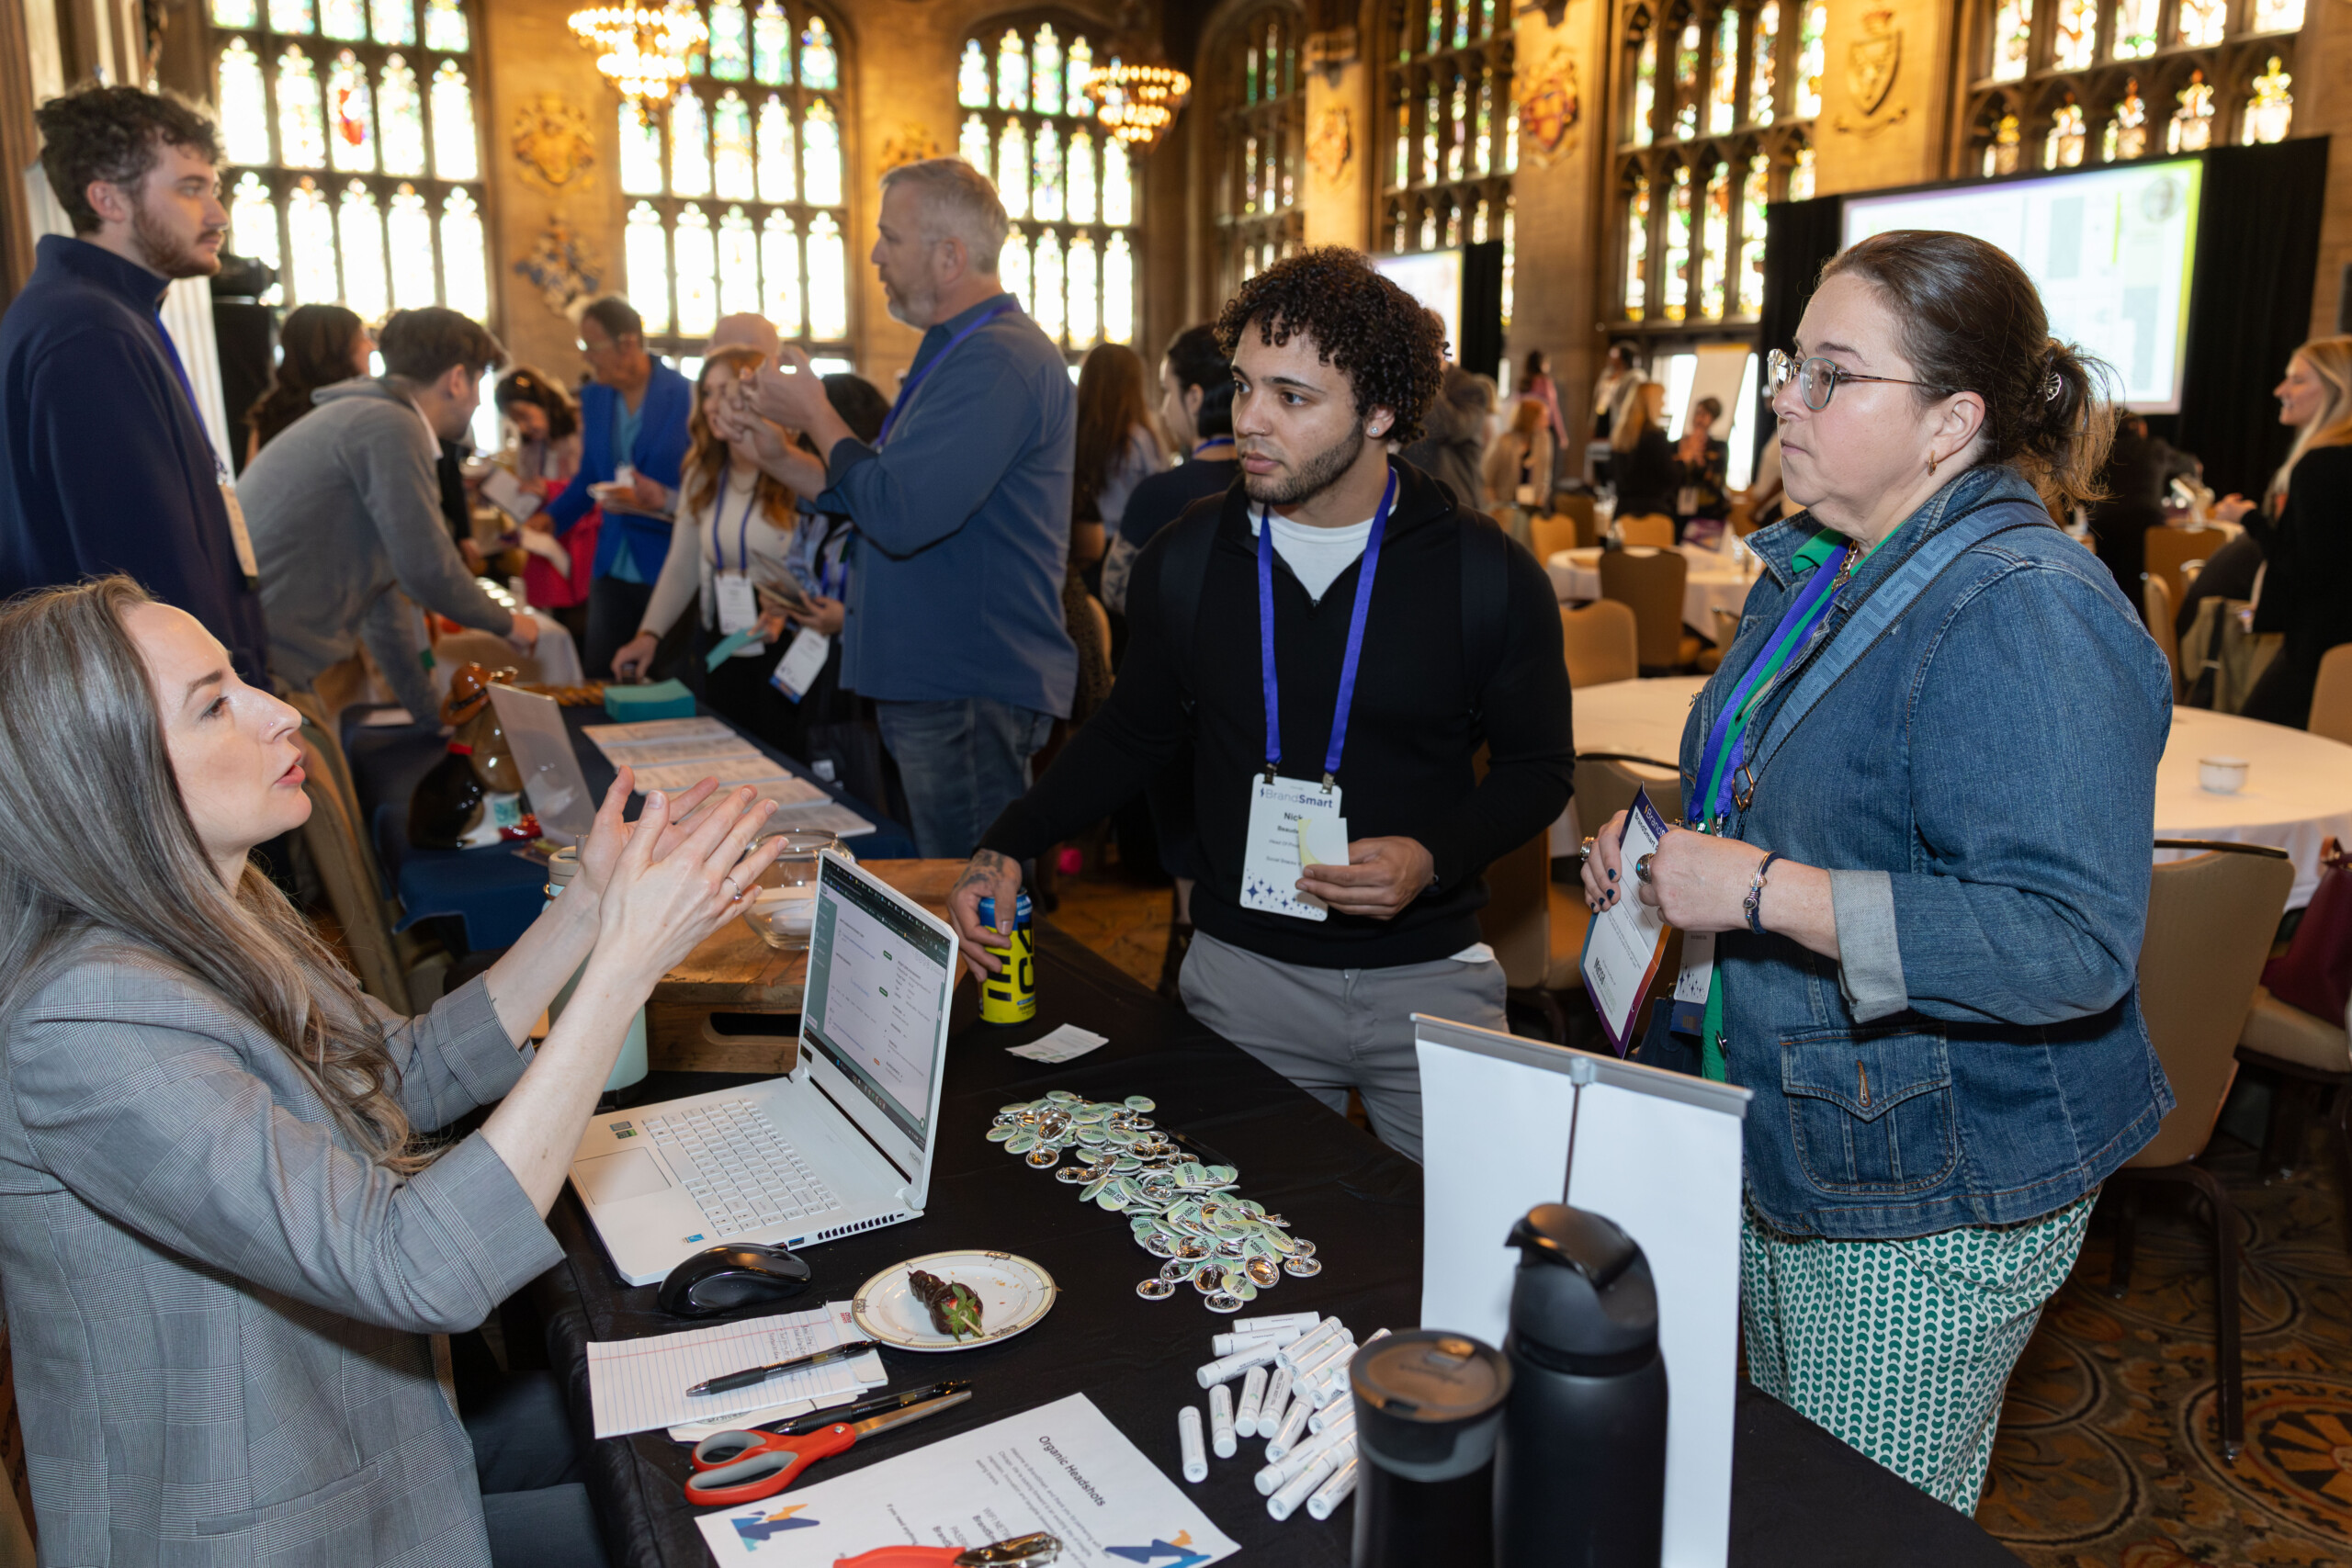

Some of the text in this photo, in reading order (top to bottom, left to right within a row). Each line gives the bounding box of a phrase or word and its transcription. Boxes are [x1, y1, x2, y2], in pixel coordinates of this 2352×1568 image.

[1265, 788, 1333, 808] BrandSmart
[1283, 812, 1303, 821] Nick
[1645, 807, 1666, 837] BrandS
[1102, 1189, 1114, 1197] LOOK
[1182, 1205, 1193, 1214] LOOK
[1185, 1207, 1198, 1217] TODAY
[1249, 1243, 1261, 1254] LOOK
[1250, 1239, 1263, 1252] TODAY
[1039, 1436, 1105, 1506] Organic Headshots
[933, 1526, 952, 1546] BrandS
[973, 1515, 997, 1543] BrandSm
[993, 1520, 1011, 1538] NETW
